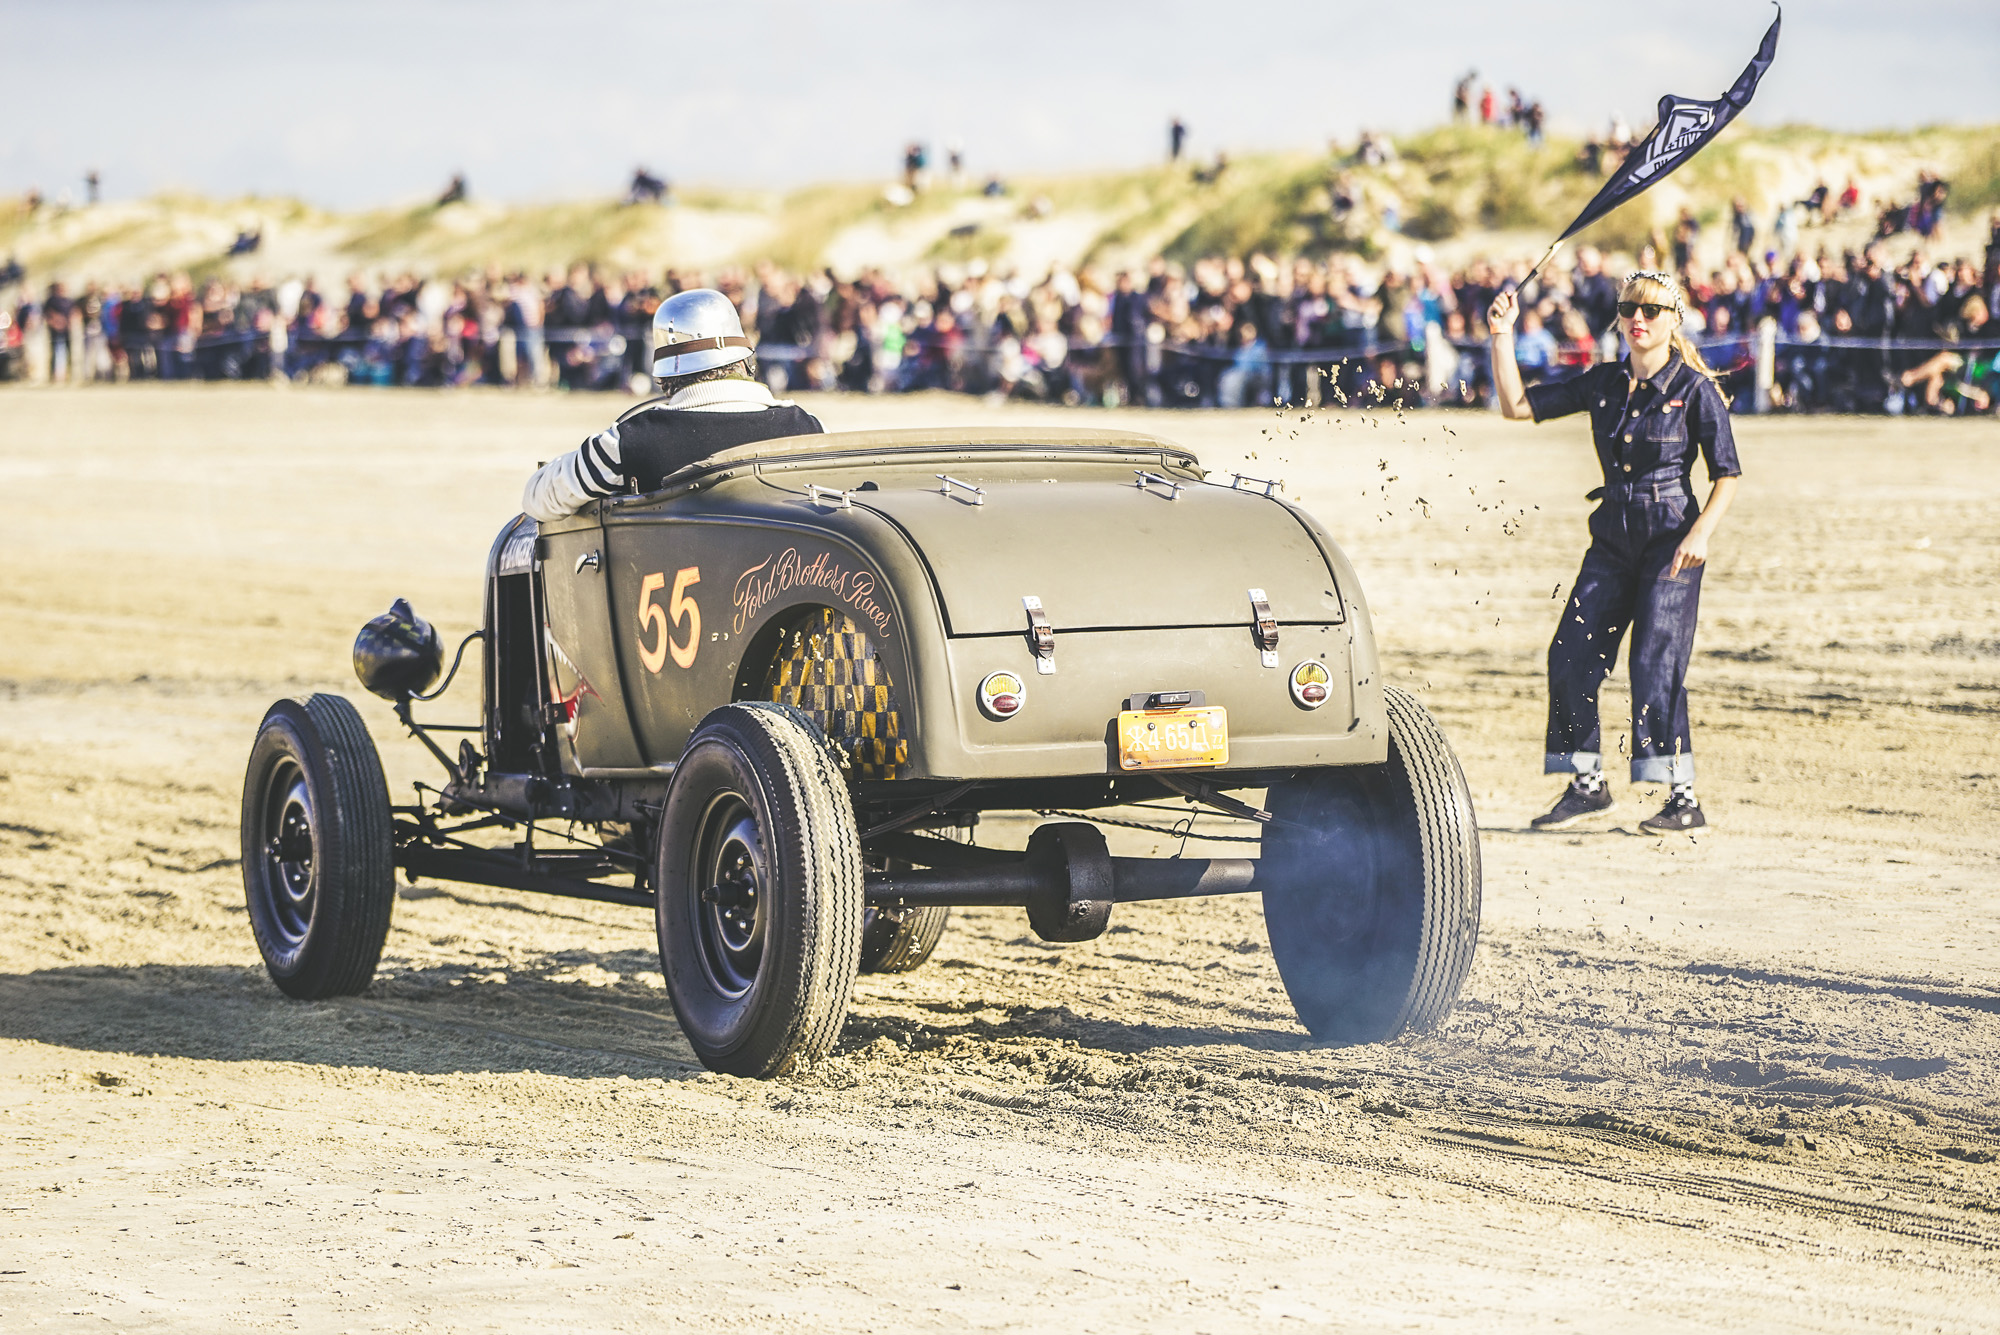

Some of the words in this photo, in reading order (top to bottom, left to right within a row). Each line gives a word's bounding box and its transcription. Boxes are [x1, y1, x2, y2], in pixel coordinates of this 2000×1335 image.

[638, 566, 701, 674] 55
[733, 554, 776, 634] Ford
[774, 548, 850, 598] Brothers
[843, 571, 891, 638] Racer
